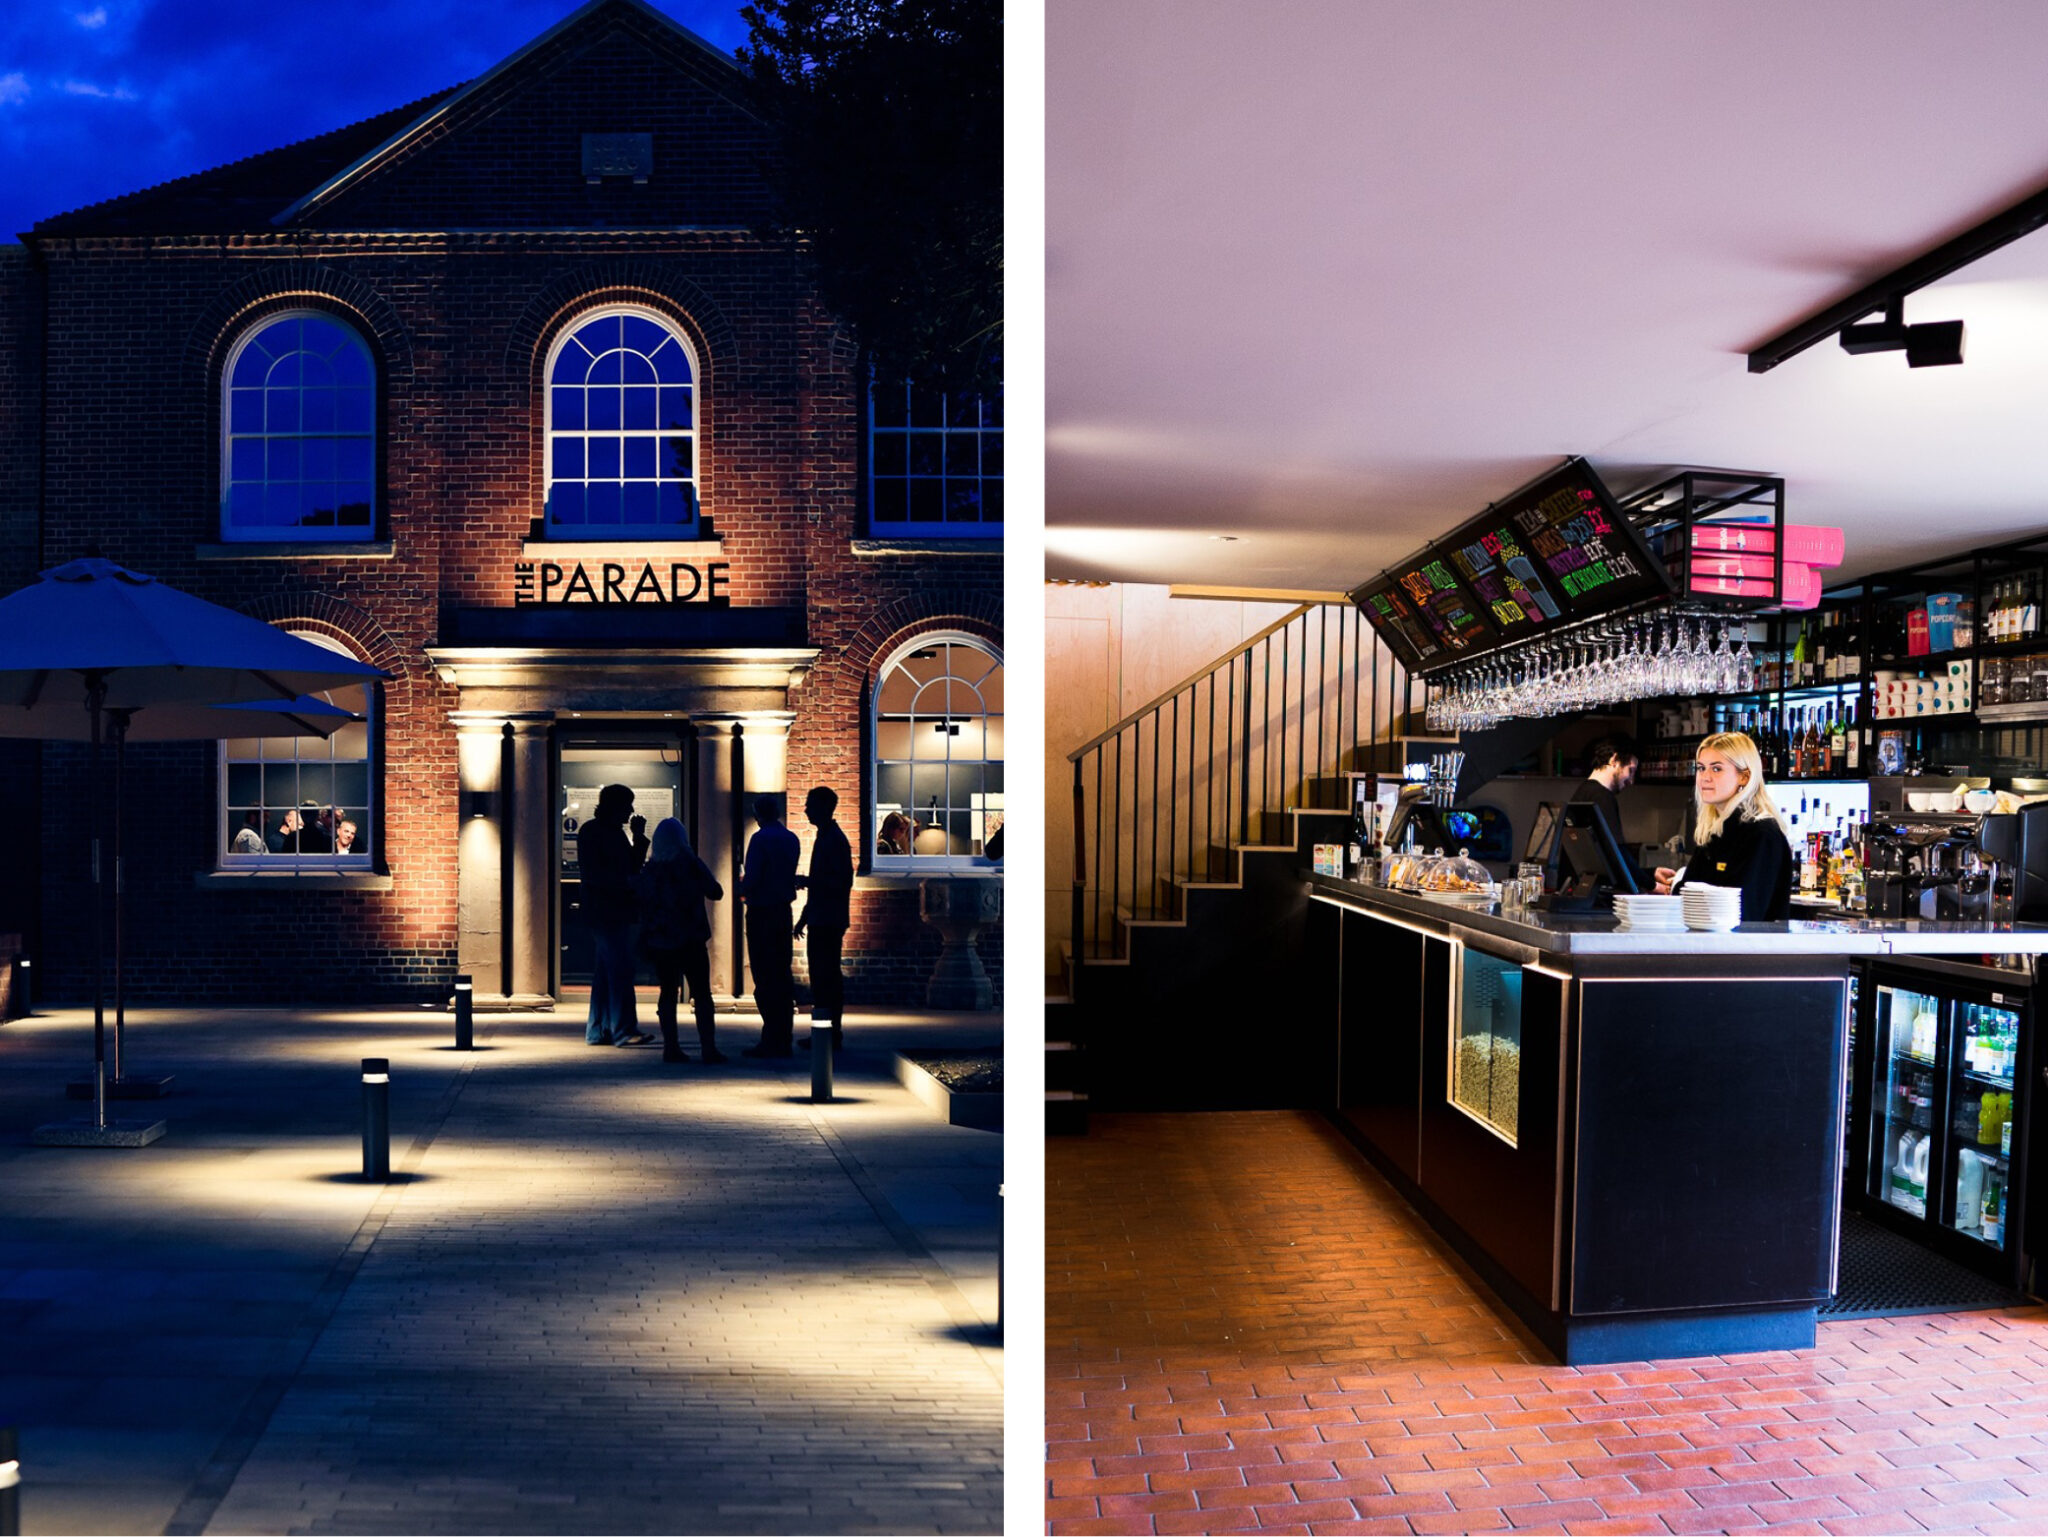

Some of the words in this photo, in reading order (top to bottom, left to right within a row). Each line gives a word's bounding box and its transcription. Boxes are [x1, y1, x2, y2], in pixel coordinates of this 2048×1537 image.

[1514, 509, 1539, 533] TEA
[515, 562, 534, 602] THE
[541, 561, 730, 604] PARADE
